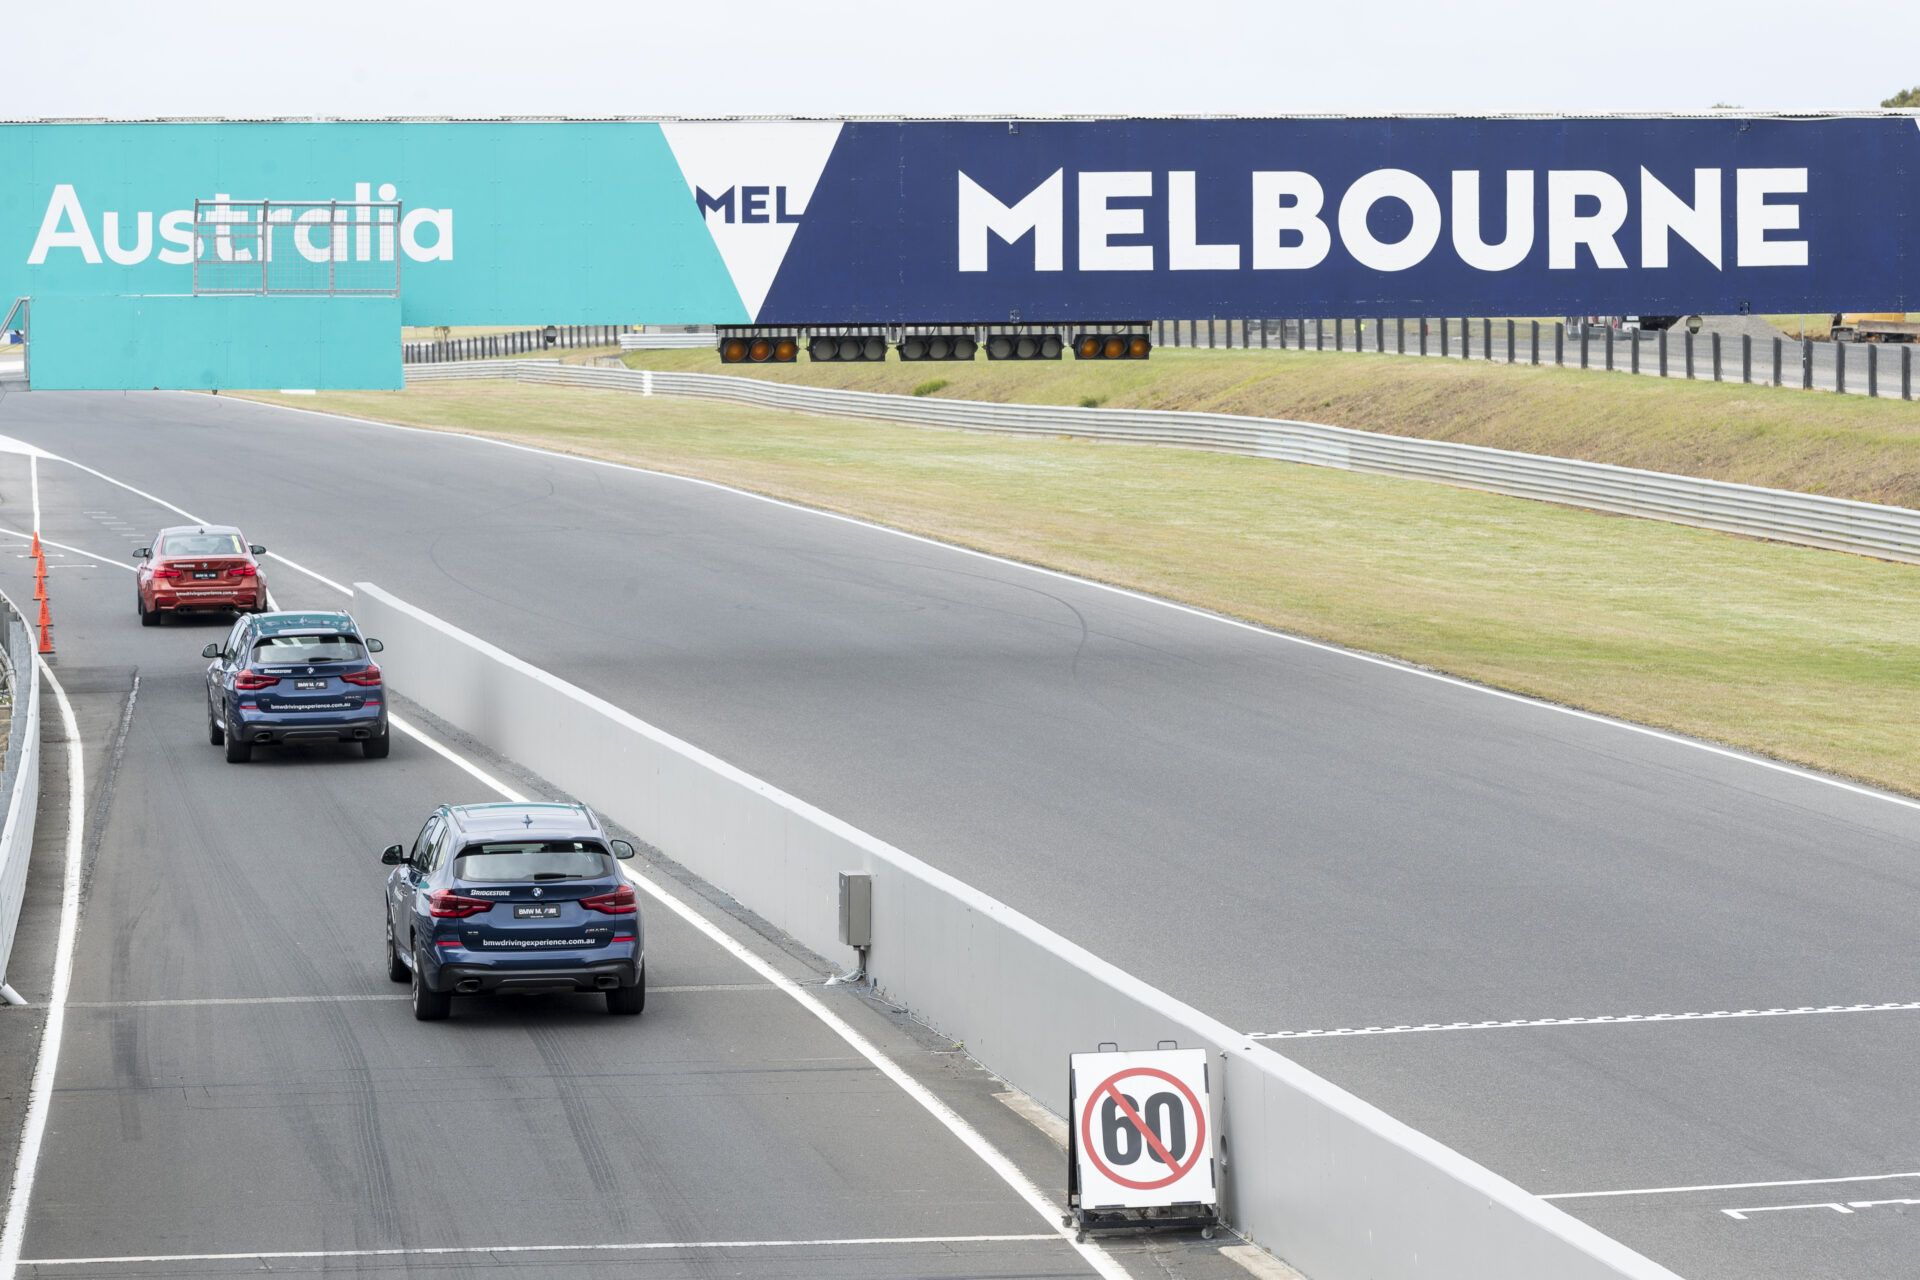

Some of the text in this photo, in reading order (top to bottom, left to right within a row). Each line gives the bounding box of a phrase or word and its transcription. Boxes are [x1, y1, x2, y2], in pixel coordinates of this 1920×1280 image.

[27, 183, 454, 265] Australia
[696, 185, 804, 224] MEL
[958, 165, 1809, 272] MELBOURNE
[270, 702, 351, 710] bmwdrivingexperience.com.au
[483, 938, 596, 947] bmwdrivingexperience.com.au
[1101, 1091, 1187, 1166] 60
